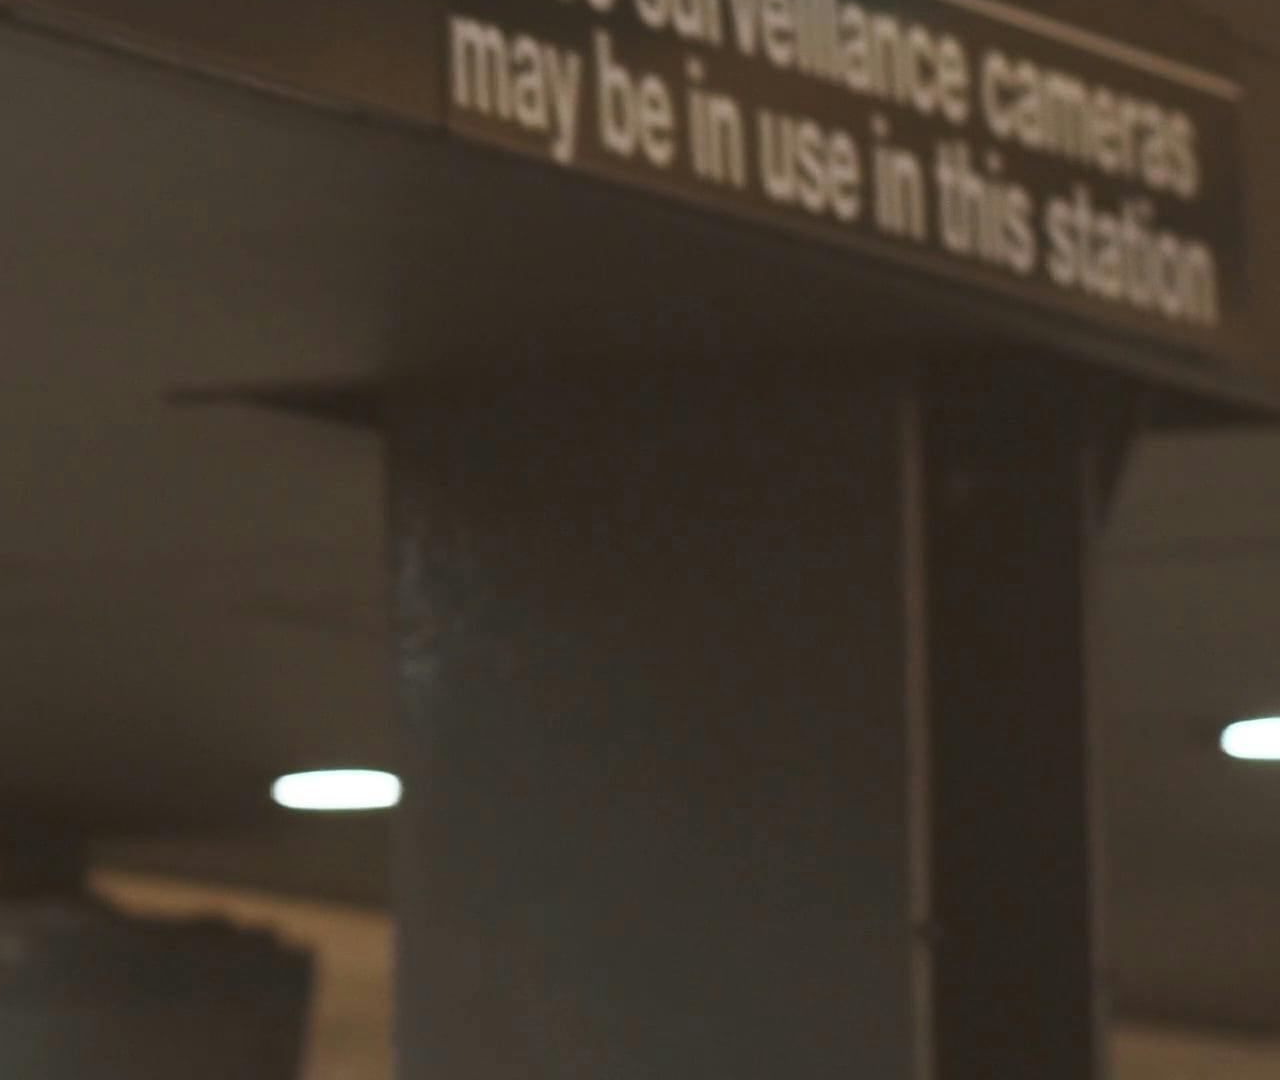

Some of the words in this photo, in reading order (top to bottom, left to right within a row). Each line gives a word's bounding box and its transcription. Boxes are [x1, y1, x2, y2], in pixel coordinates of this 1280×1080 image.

[451, 18, 580, 164] may
[596, 28, 674, 166] be
[684, 56, 745, 187] in
[759, 112, 860, 220] use
[872, 115, 924, 238] in
[935, 141, 1036, 274] this
[1045, 186, 1215, 326] station
[984, 50, 1197, 197] cameras
